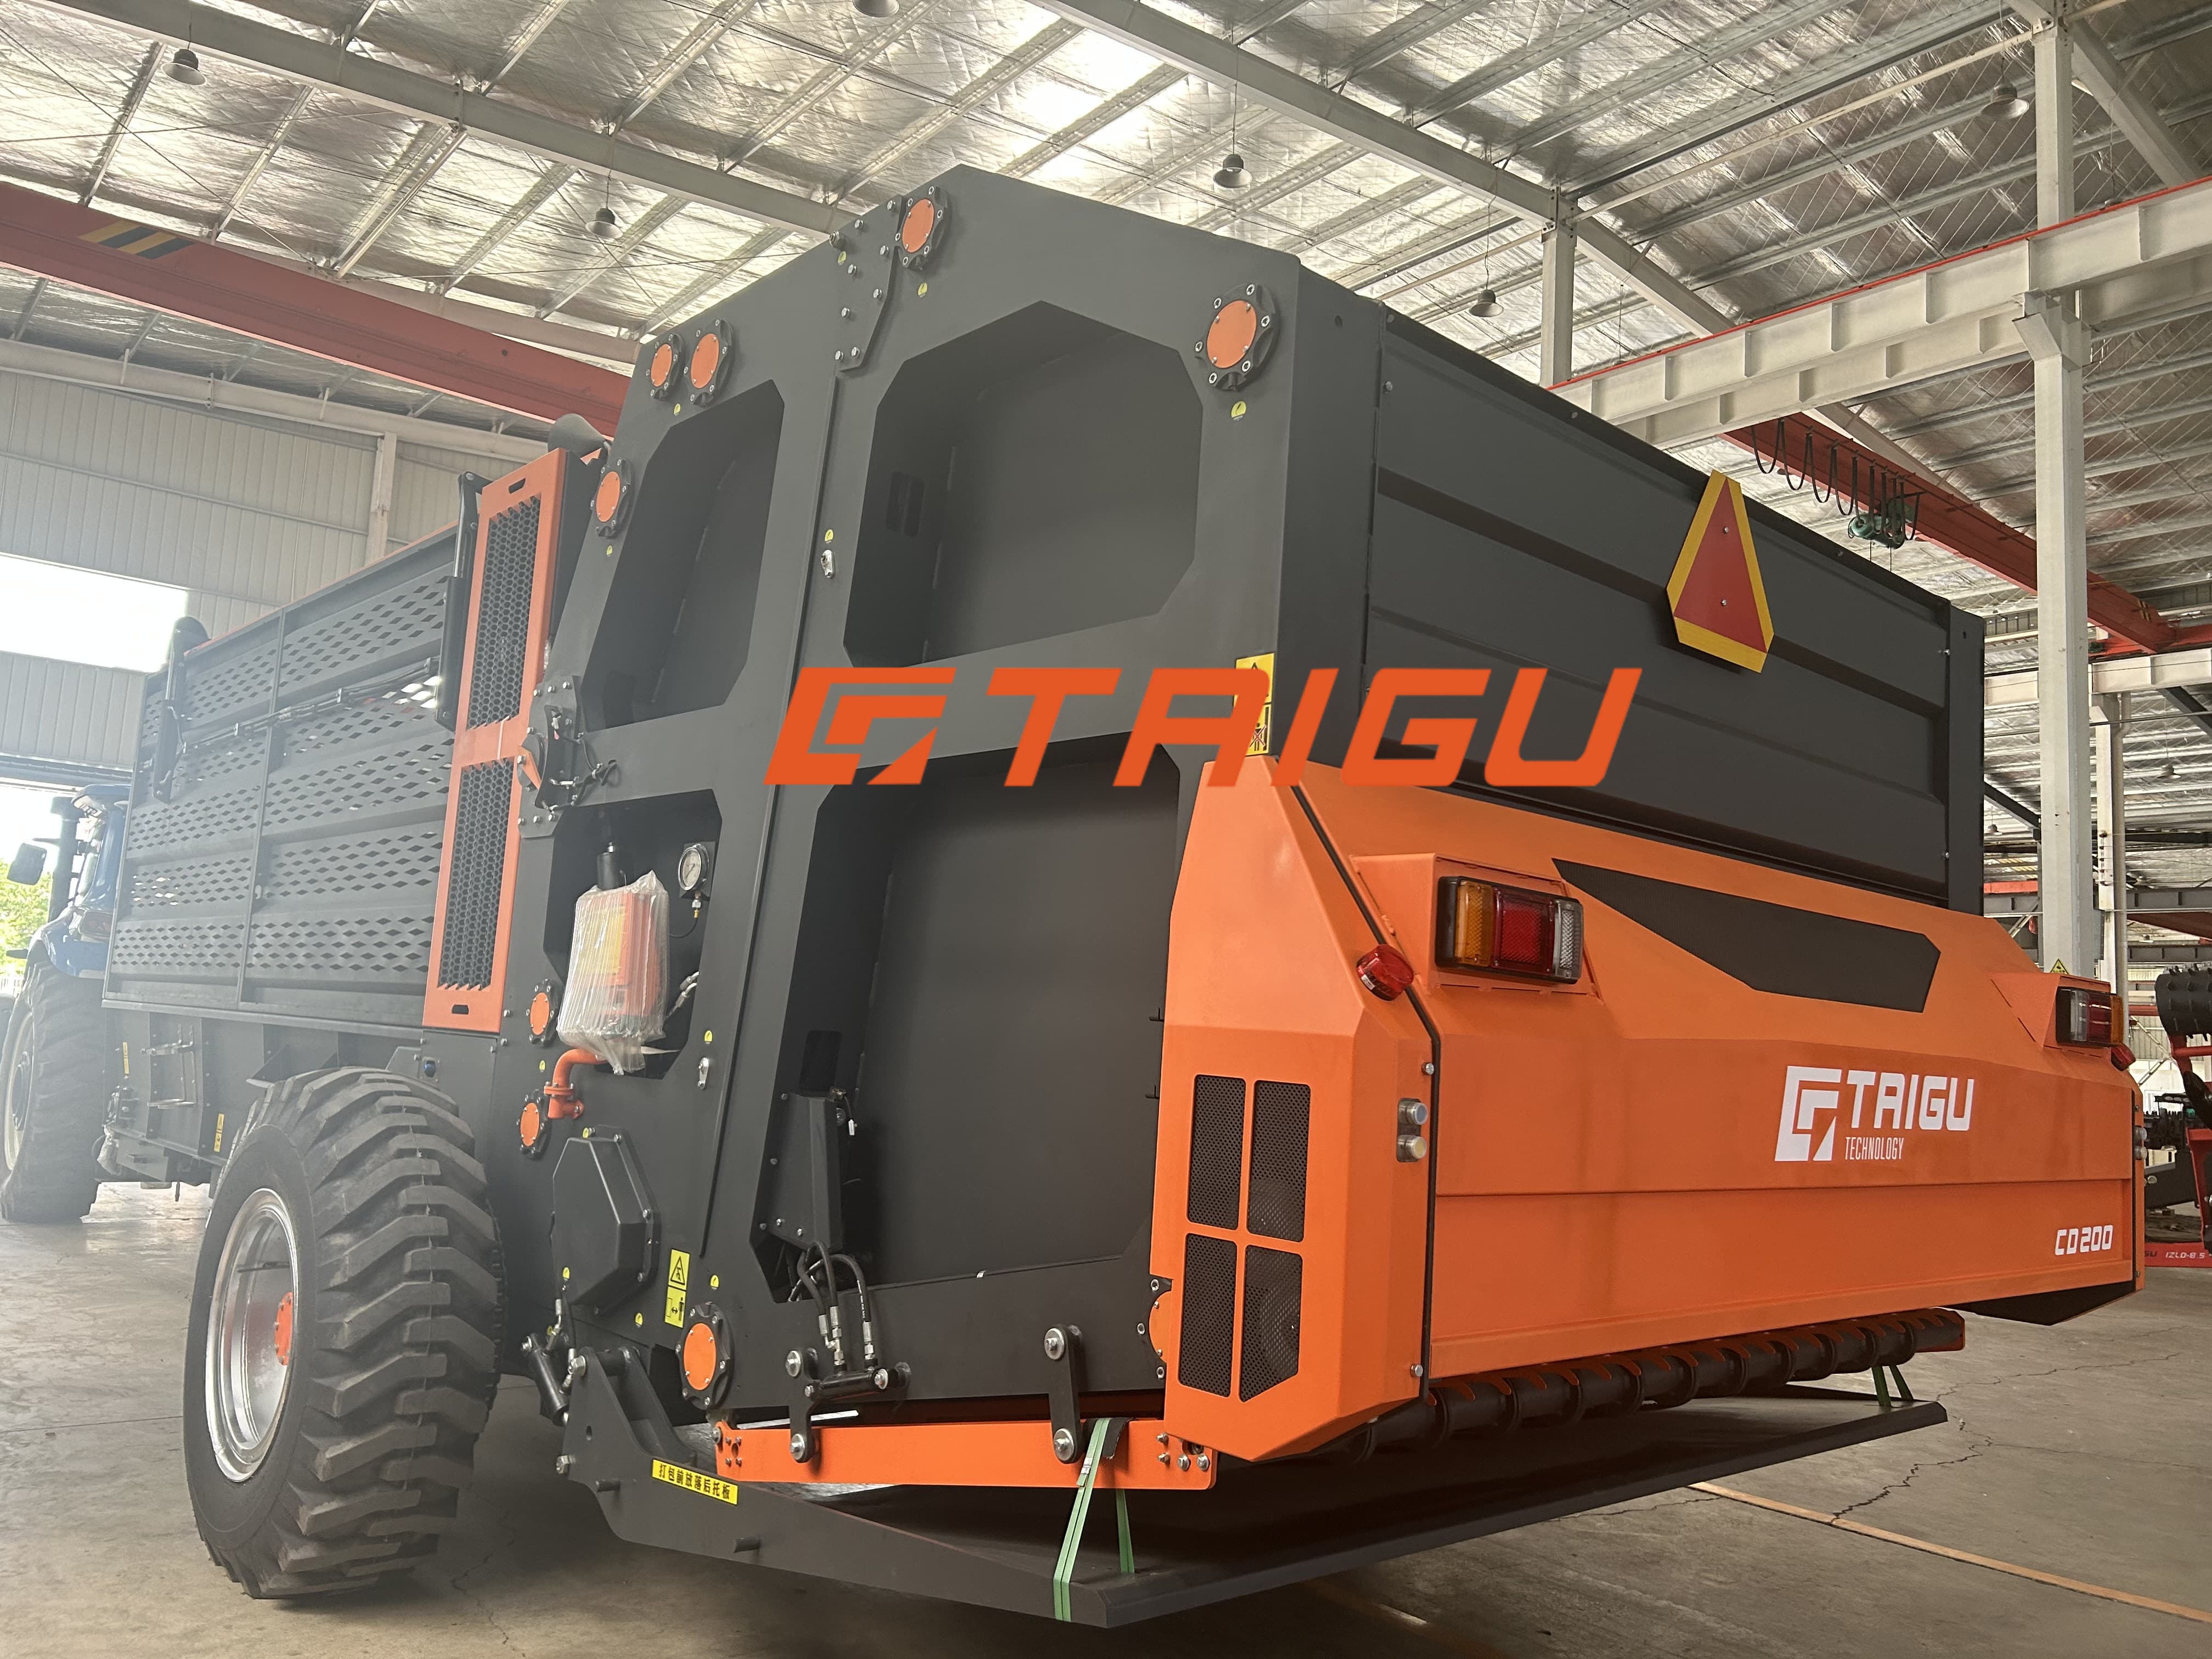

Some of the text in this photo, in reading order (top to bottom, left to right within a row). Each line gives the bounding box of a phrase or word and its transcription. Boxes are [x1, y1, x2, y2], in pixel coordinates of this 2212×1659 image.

[1847, 1070, 1974, 1131] TAIGU
[1845, 1136, 1904, 1160] TECHNOLOGY
[2055, 1224, 2113, 1256] CD200
[659, 1463, 730, 1500] 打包前放落后托板
